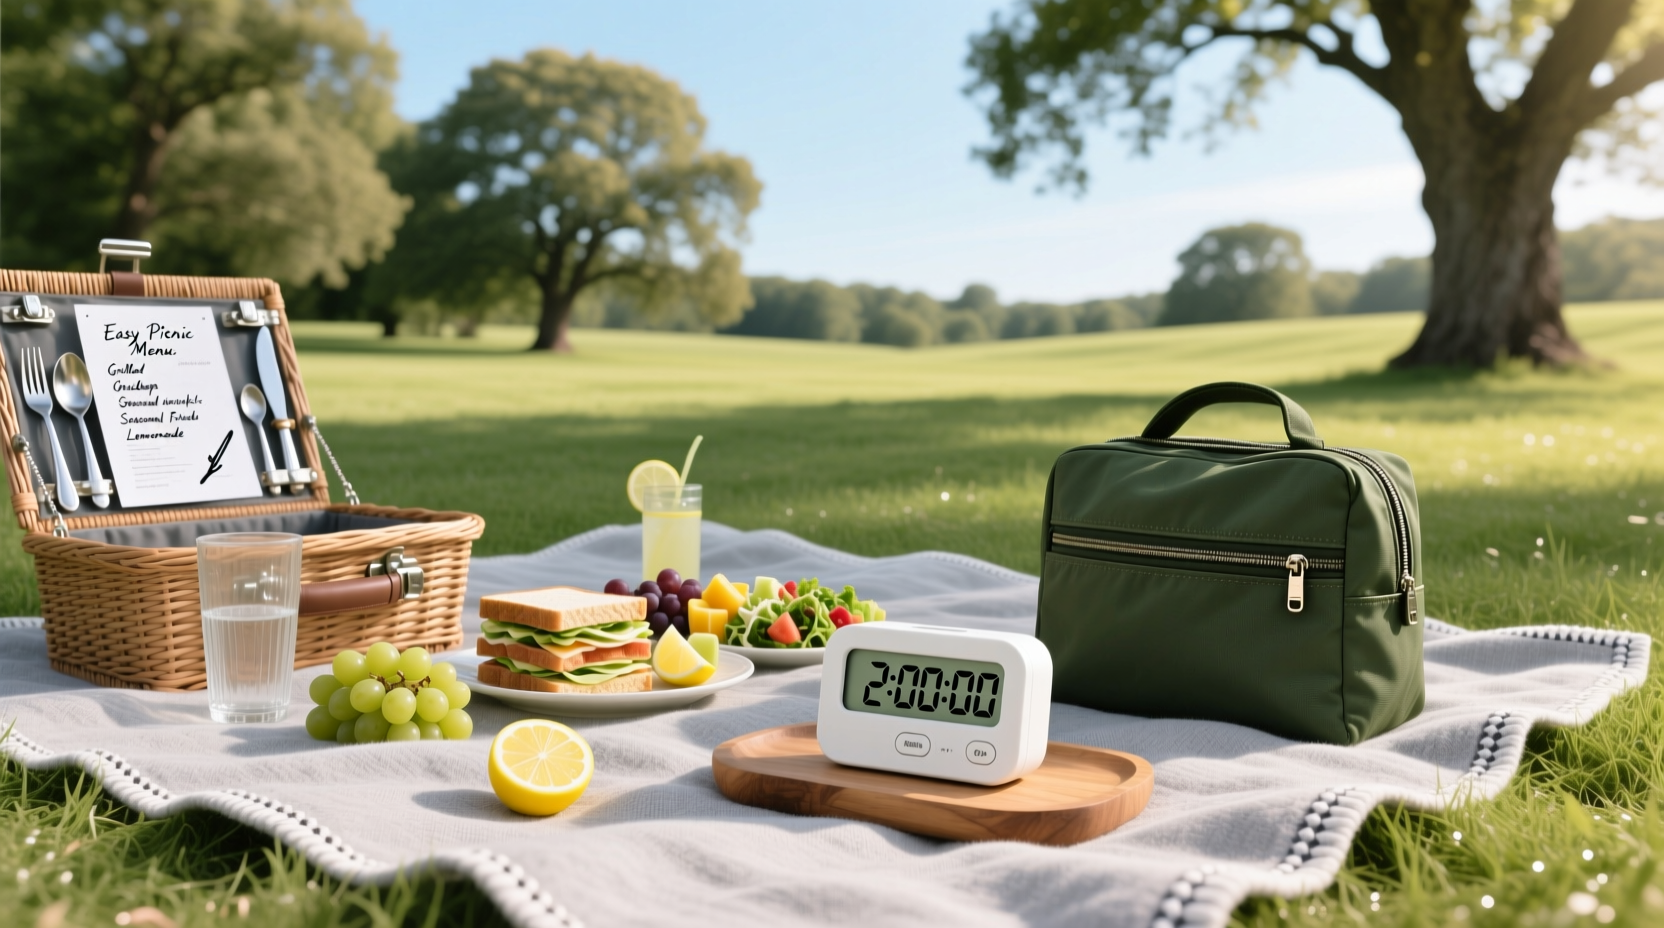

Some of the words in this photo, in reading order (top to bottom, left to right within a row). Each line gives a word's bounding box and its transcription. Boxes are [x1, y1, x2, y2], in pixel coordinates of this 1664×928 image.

[104, 323, 140, 347] Easy
[146, 323, 194, 341] Picnic
[863, 661, 999, 718] 2:00:00
